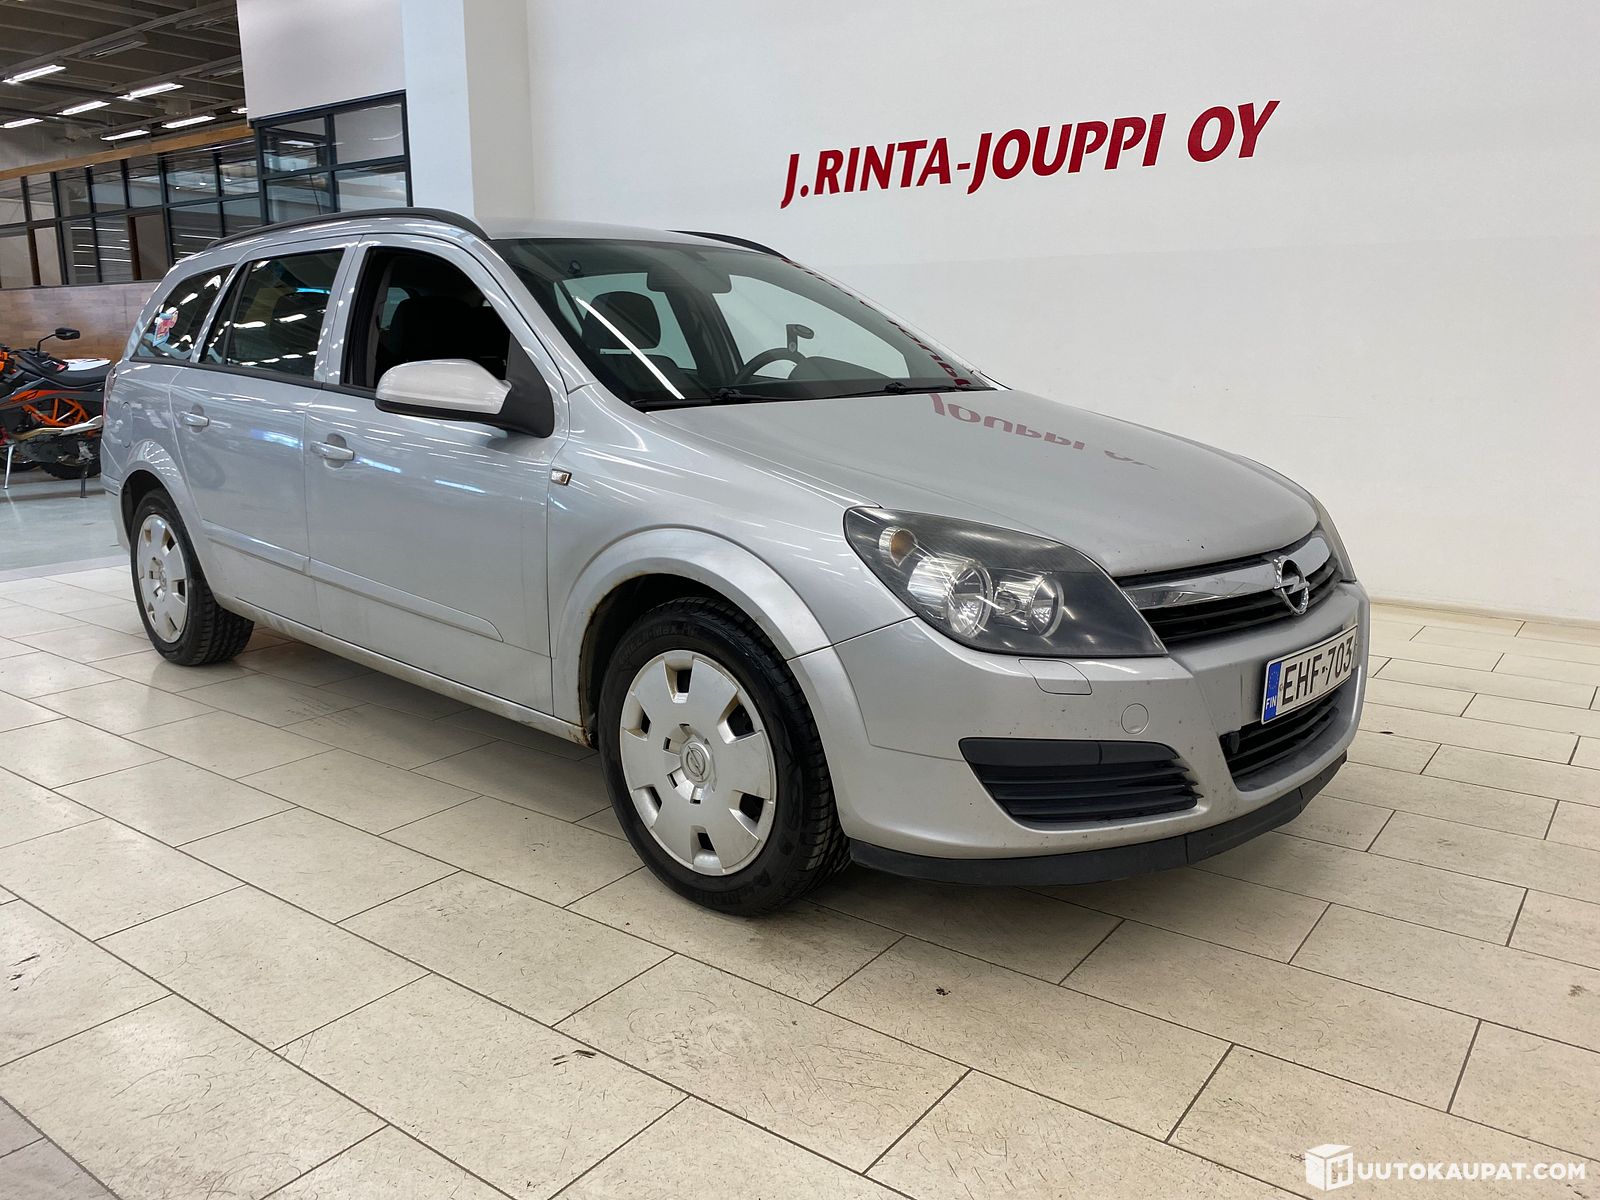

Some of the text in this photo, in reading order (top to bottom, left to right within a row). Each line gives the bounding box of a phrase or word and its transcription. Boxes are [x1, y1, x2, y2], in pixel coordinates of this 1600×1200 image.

[781, 100, 1281, 209] J.RINTA-JOUPPI OY
[1265, 695, 1278, 711] FIN
[1281, 635, 1354, 706] EHF-703
